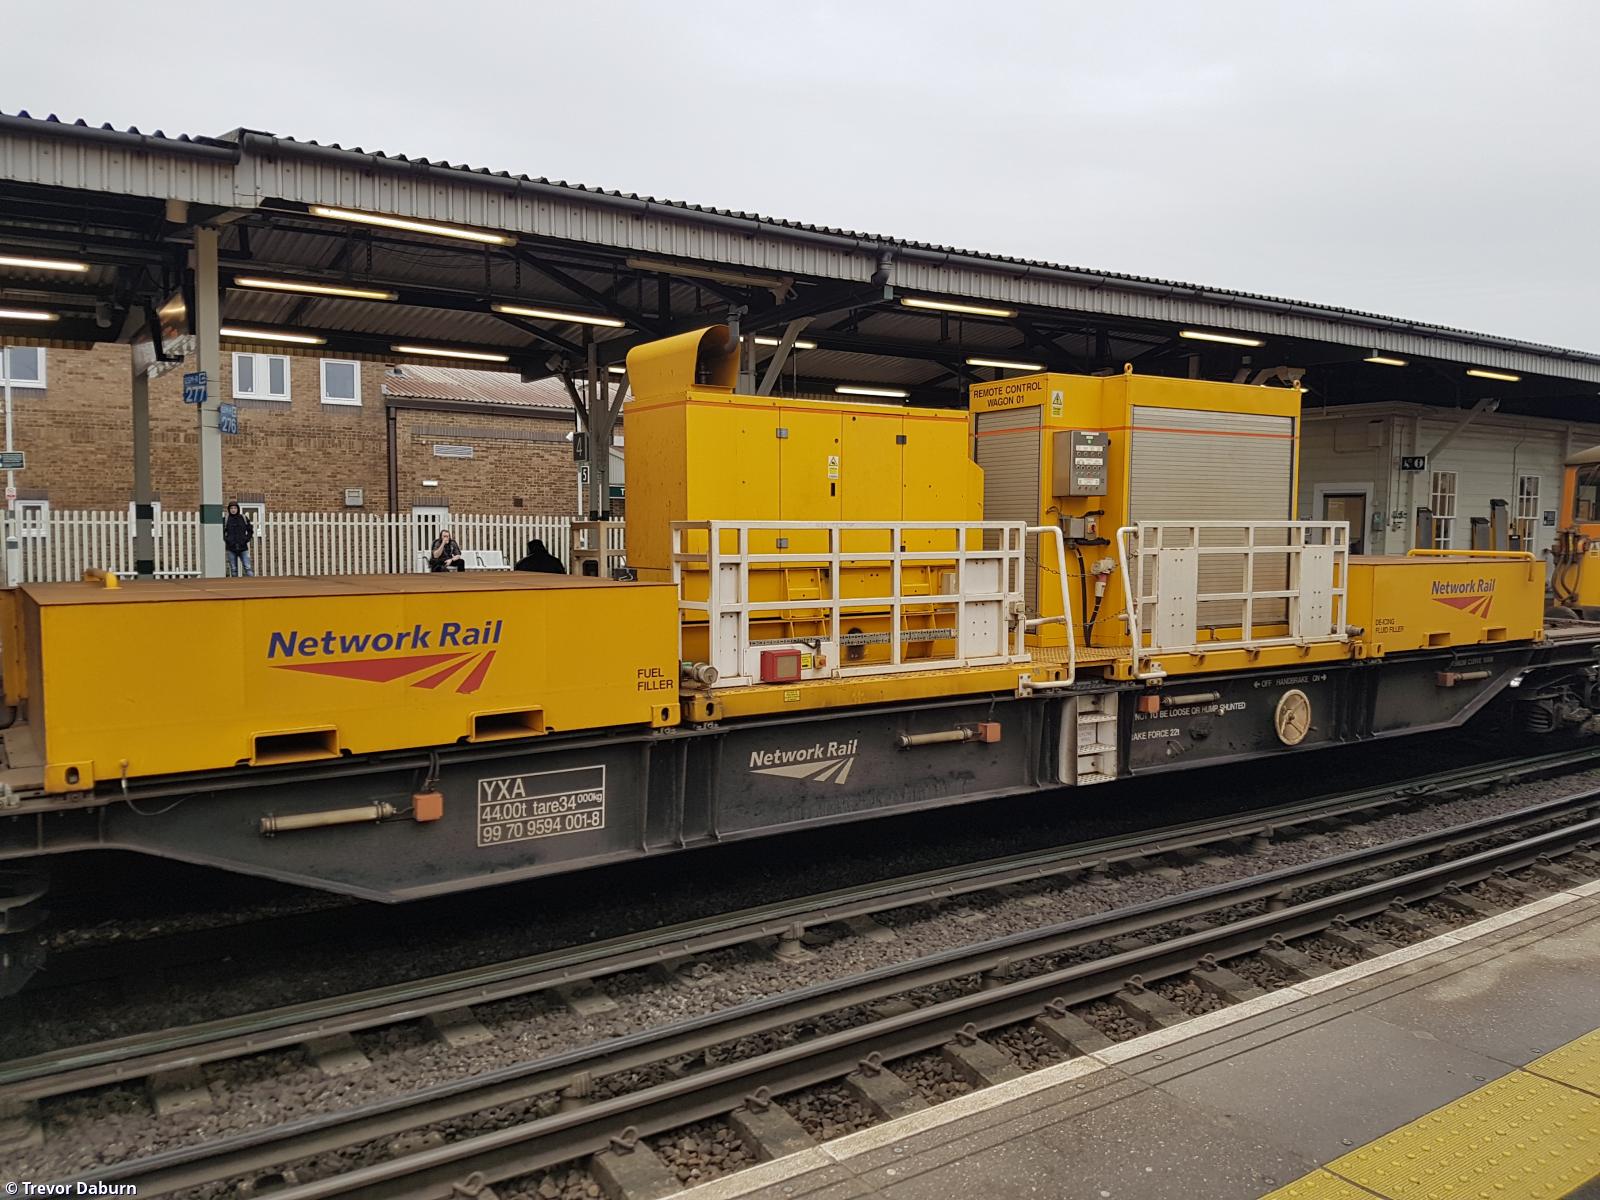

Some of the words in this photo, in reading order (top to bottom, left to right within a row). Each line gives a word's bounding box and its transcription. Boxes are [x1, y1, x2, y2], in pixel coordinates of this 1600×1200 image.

[186, 385, 205, 402] 277
[973, 387, 1003, 399] REMOTE
[1005, 381, 1043, 394] CONTROL
[987, 397, 1014, 407] WAGON
[222, 416, 237, 433] 276
[576, 436, 582, 457] 4
[582, 469, 587, 481] 5
[1431, 579, 1475, 595] Network
[1477, 578, 1496, 592] Rail
[267, 624, 432, 659] Network
[438, 619, 503, 648] Rail
[637, 667, 665, 679] FUEL
[637, 679, 674, 692] FILLER
[1160, 709, 1169, 718] BE
[1170, 707, 1191, 717] LOOSE
[1191, 706, 1200, 715] OR
[1201, 704, 1219, 713] HUMP
[1219, 701, 1246, 711] SHUNTED
[1148, 729, 1169, 739] FORCE
[749, 743, 824, 768] Network
[827, 738, 858, 758] Rail
[482, 778, 526, 801] YXA
[482, 802, 527, 821] 44.00t
[483, 825, 502, 843] 99
[506, 822, 523, 839] 70
[527, 817, 561, 836] 9594
[565, 811, 600, 831] 001-8
